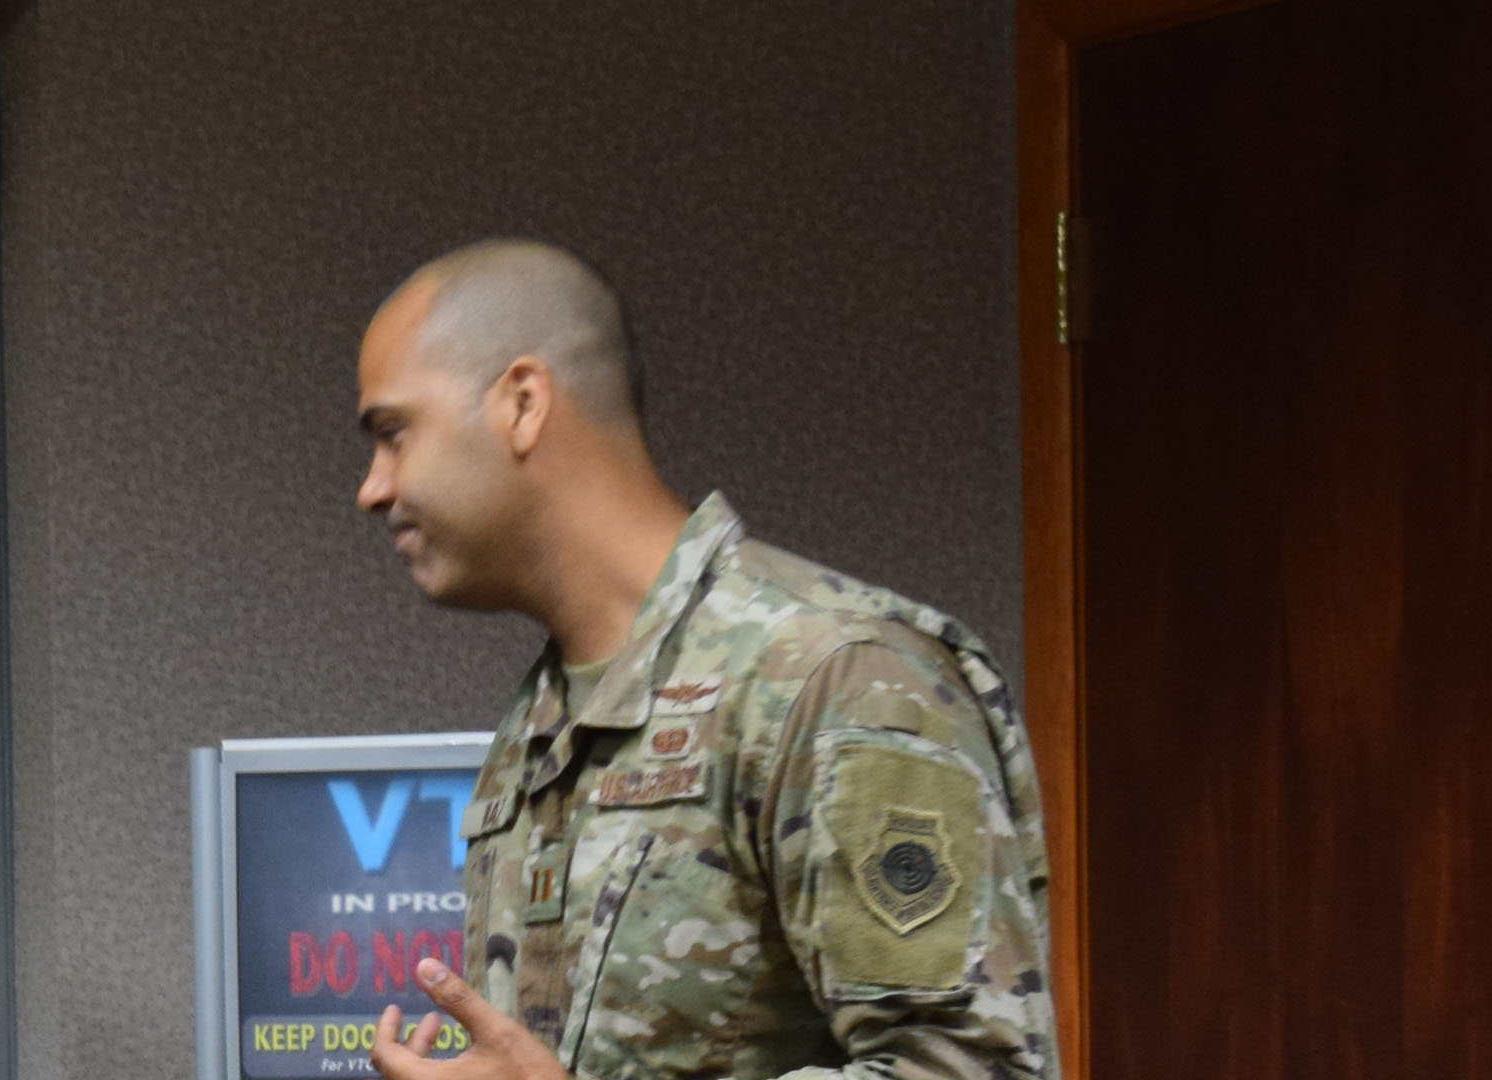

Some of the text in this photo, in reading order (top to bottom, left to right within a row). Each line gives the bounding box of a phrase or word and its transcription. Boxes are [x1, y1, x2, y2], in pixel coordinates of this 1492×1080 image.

[331, 891, 467, 914] IN PRO
[288, 930, 358, 995] DO
[254, 1023, 316, 1052] KEEP
[323, 1023, 376, 1051] DOO
